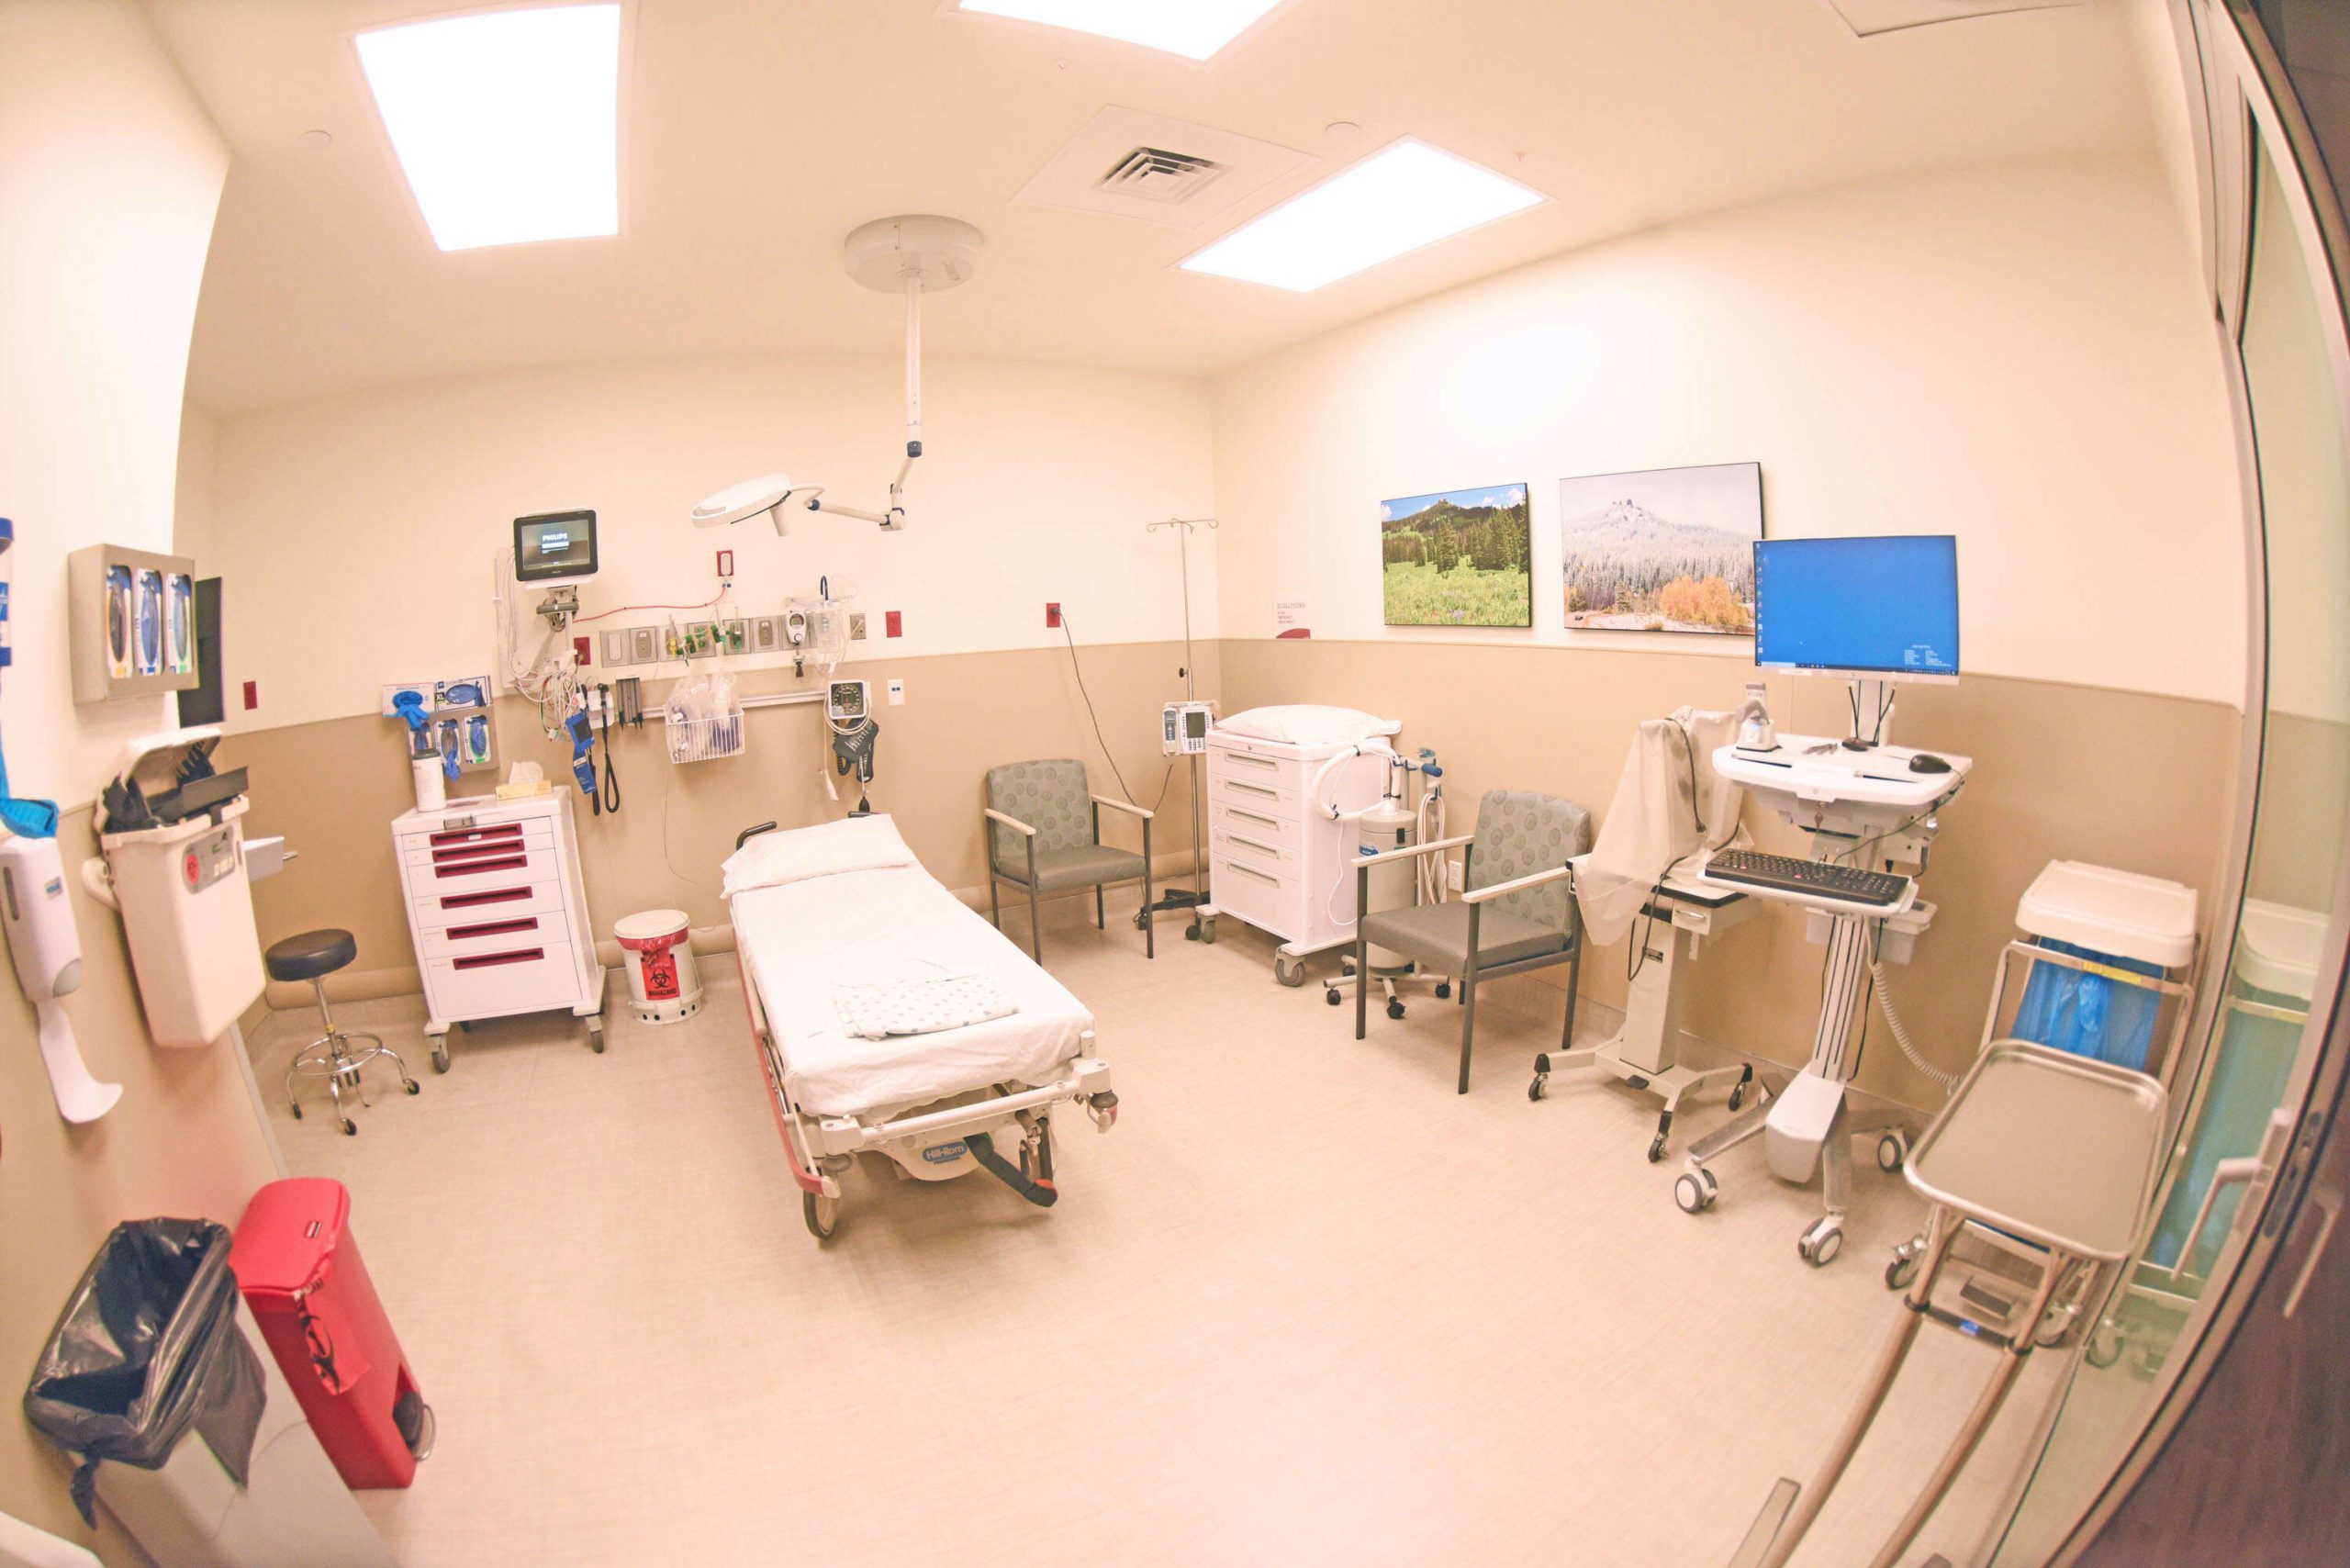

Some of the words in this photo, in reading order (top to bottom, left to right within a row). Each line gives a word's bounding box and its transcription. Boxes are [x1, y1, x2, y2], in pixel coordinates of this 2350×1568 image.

[542, 532, 567, 542] PHILIPS
[648, 988, 677, 996] BIOHAZARD
[927, 1146, 964, 1159] Hill-Rom
